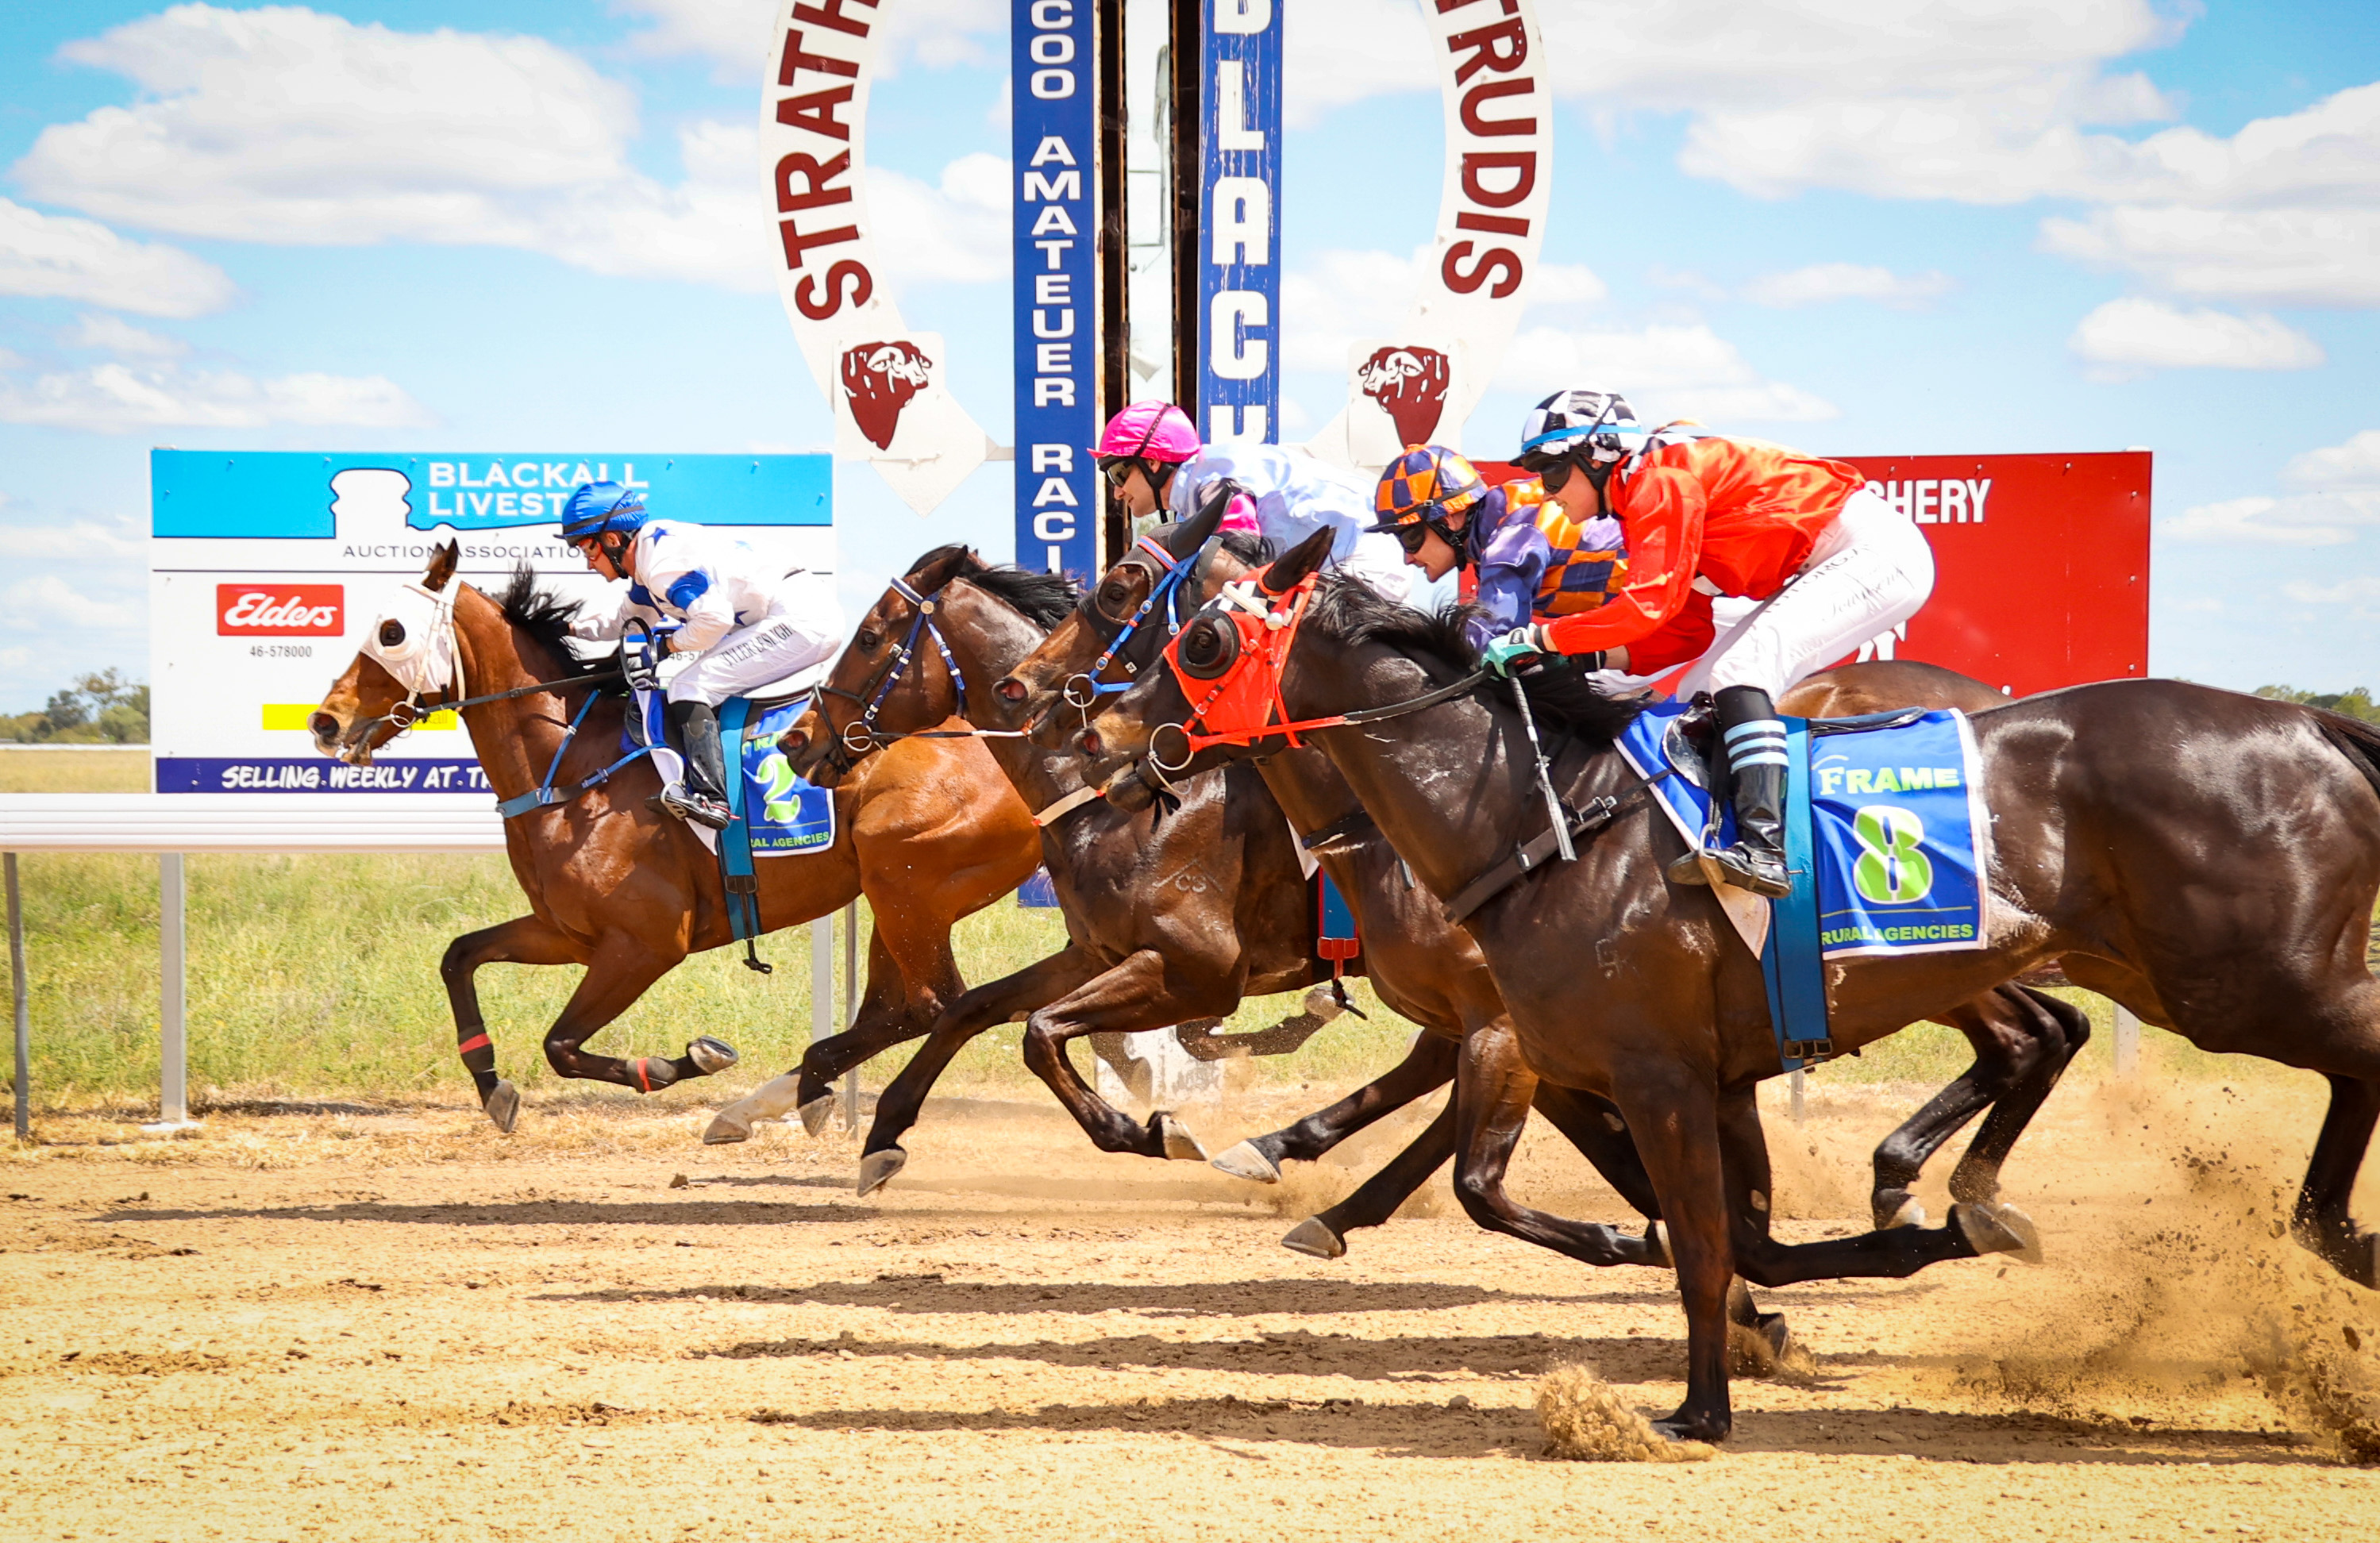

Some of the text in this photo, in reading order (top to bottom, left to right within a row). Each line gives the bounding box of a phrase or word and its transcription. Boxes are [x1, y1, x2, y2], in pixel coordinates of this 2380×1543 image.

[1023, 136, 1081, 407] AMATEUER
[429, 462, 649, 488] BLACKALL
[429, 492, 649, 516] LIVEST
[1032, 444, 1079, 594] RACI
[458, 545, 581, 558] SSOCIATIO
[224, 592, 338, 627] Elders
[250, 645, 313, 658] 46-578000
[719, 642, 757, 666] TYLER
[221, 765, 320, 789] SELLING
[329, 766, 418, 789] WEEKLY
[423, 765, 460, 789] AT
[755, 753, 802, 824] 2
[1818, 766, 1961, 795] FRAME
[772, 831, 830, 847] AGENCIES
[1852, 804, 1934, 905] 8
[1821, 924, 1974, 945] RURAL AGENCIES
